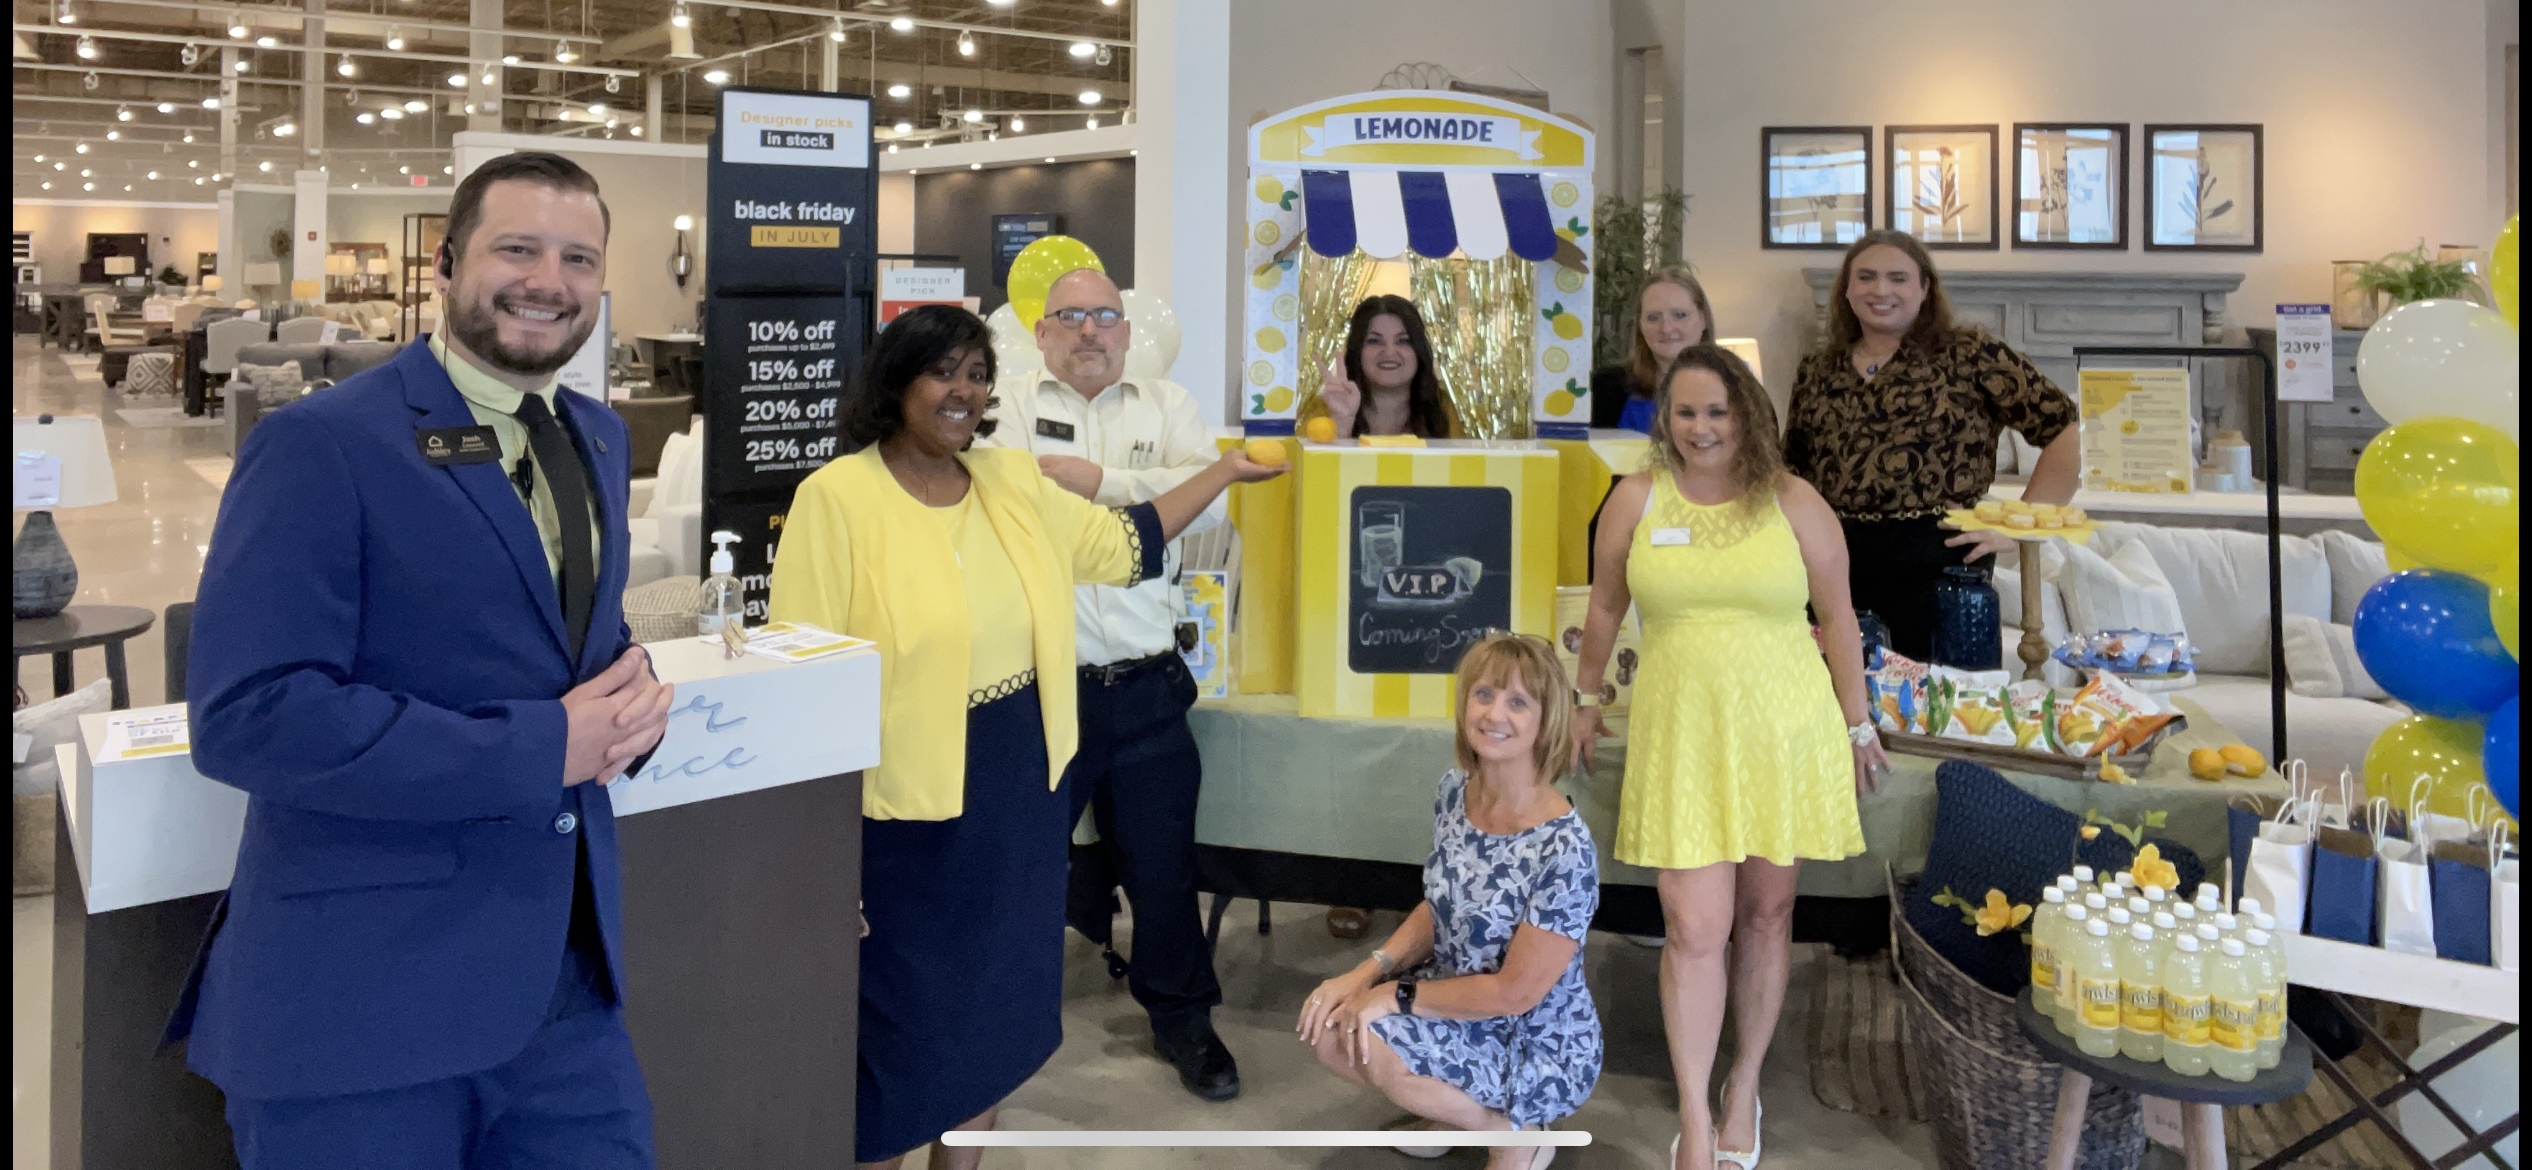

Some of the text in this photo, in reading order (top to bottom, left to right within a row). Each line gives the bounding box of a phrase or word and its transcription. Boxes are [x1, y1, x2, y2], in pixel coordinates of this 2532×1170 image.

[741, 111, 854, 130] Designer picks
[1354, 117, 1494, 143] LEMONADE
[767, 131, 828, 148] in stock
[735, 200, 856, 225] black friday
[759, 230, 831, 244] IN JULY
[895, 277, 951, 285] DESIGNER
[910, 287, 935, 295] PICK
[748, 320, 836, 342] 10% off
[748, 358, 836, 381] 15% off
[745, 398, 838, 421] 20% off
[745, 437, 837, 461] 25% off
[1359, 611, 1441, 663] Coming
